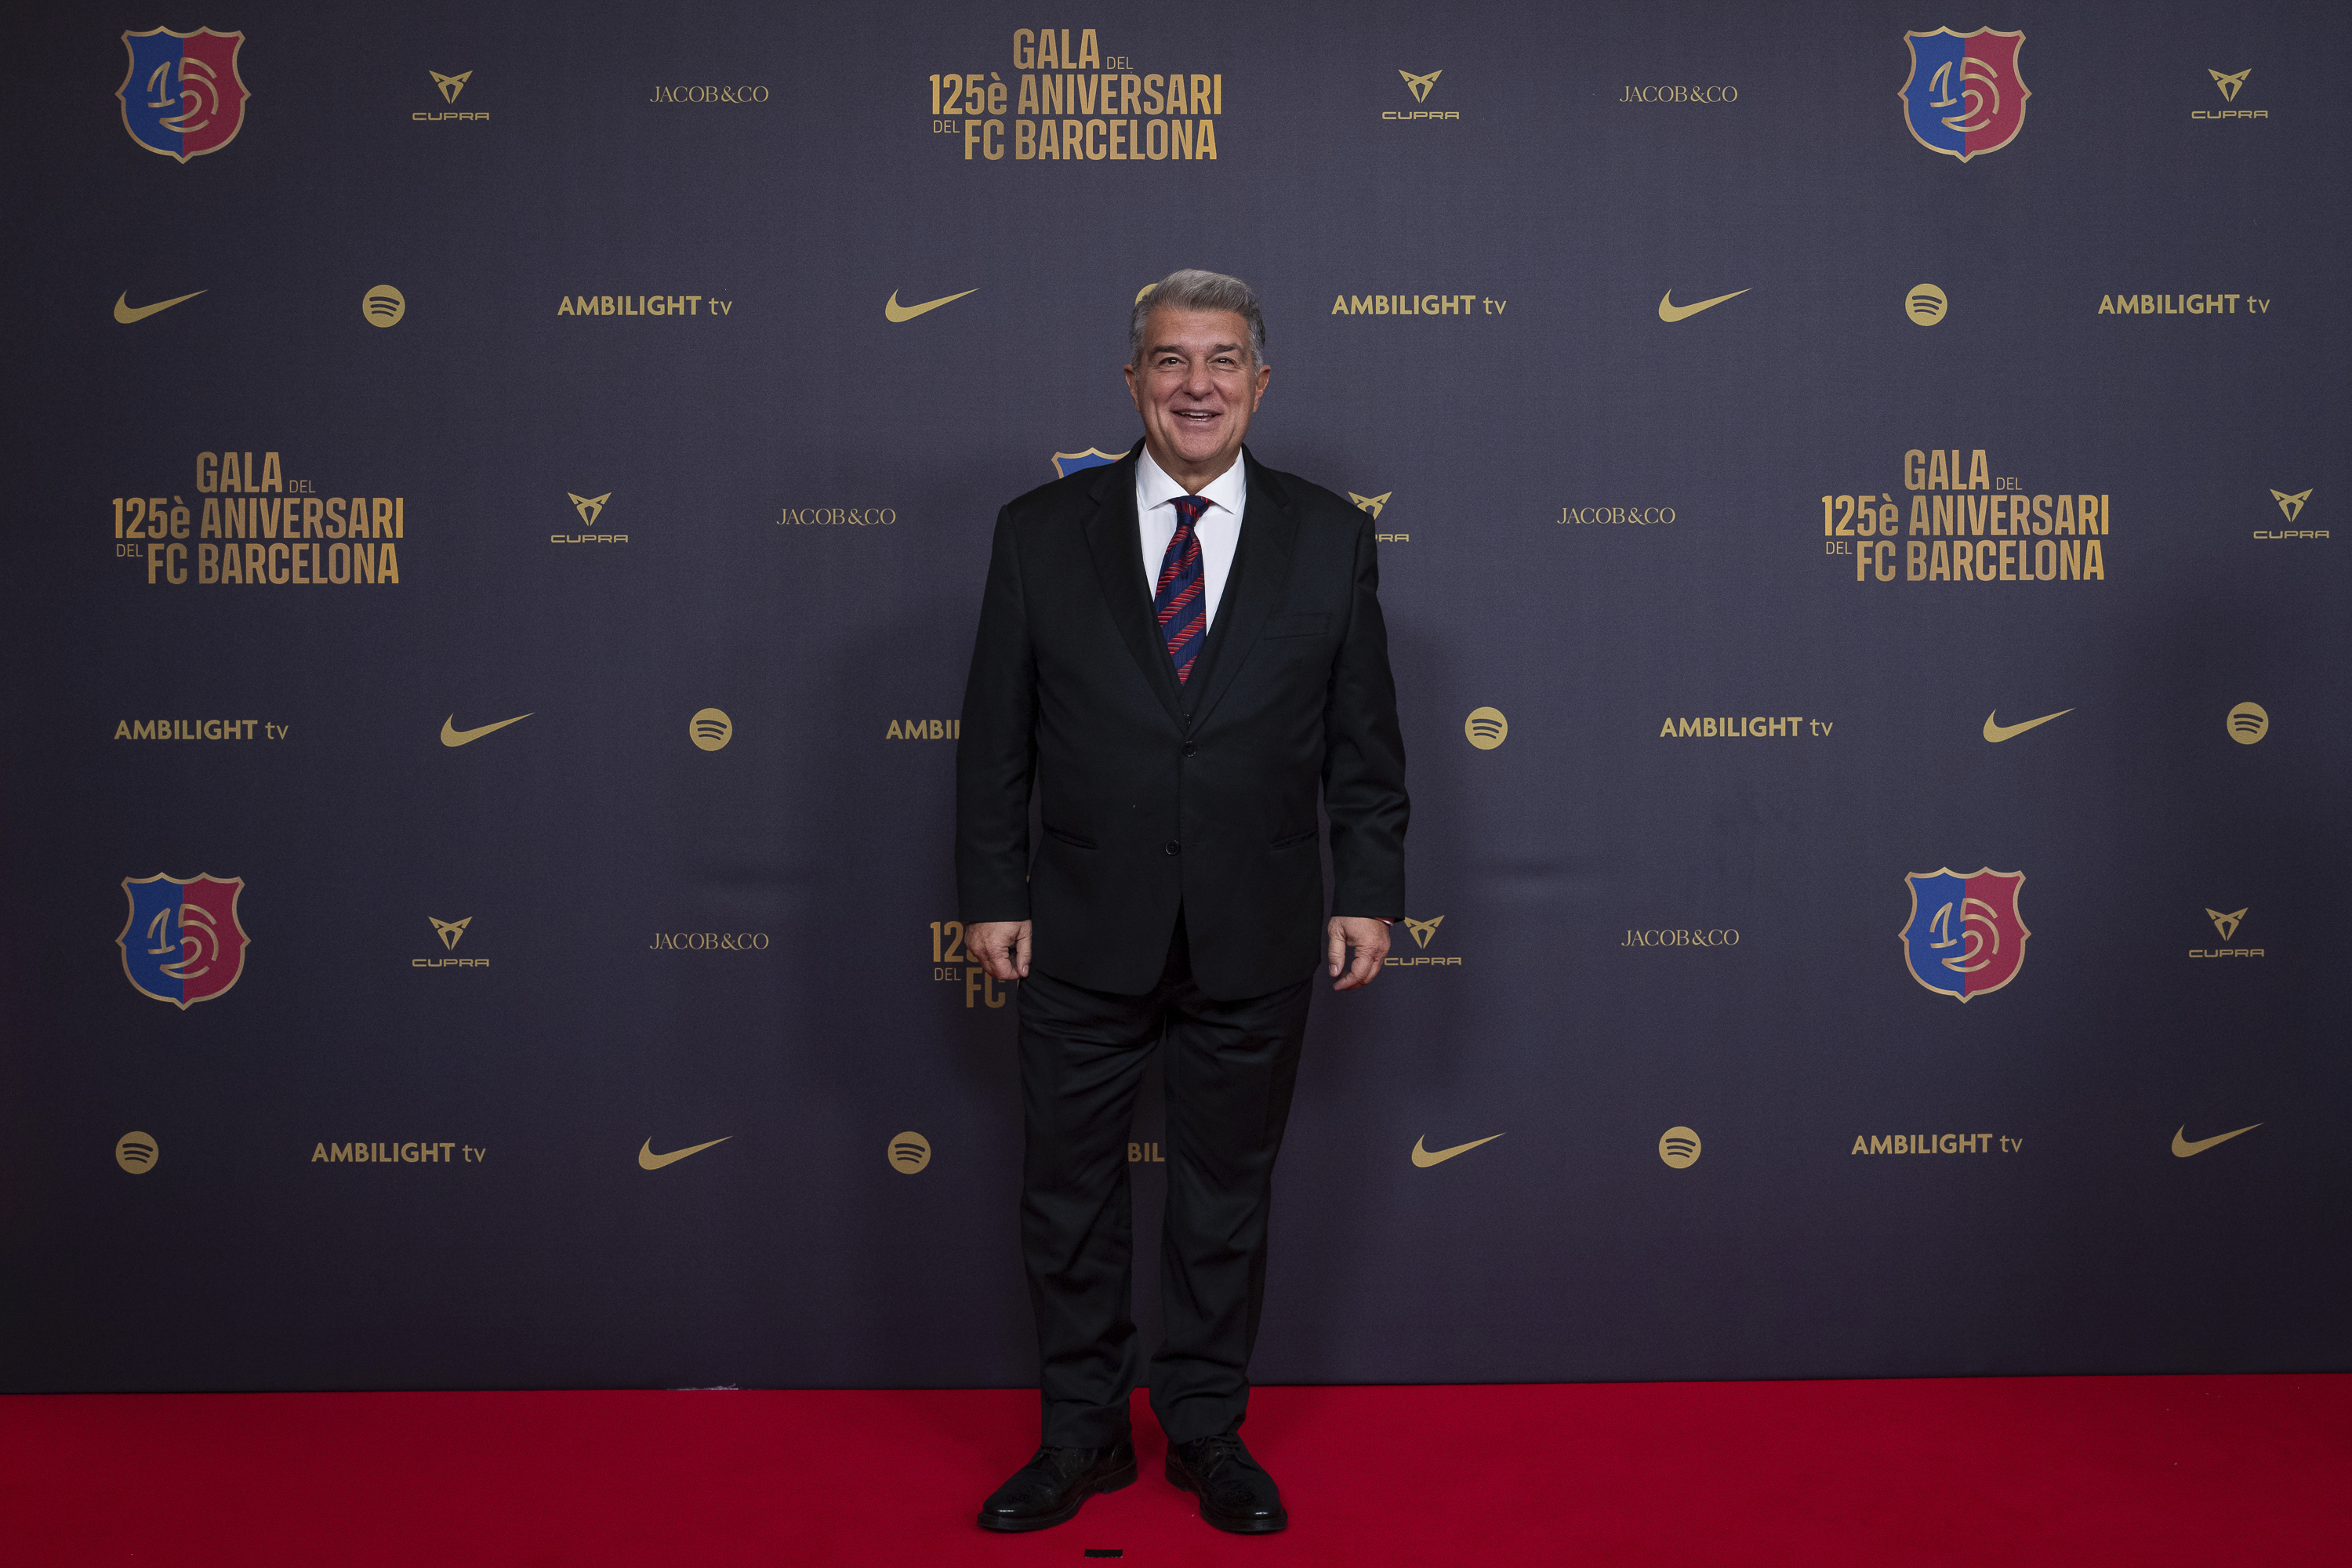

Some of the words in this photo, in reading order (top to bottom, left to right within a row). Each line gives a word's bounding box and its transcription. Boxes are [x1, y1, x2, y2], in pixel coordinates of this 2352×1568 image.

[1014, 29, 1099, 69] GALA
[1107, 56, 1133, 69] DEL
[650, 86, 768, 103] JACOB&CO
[930, 72, 1007, 114] 125è
[1018, 74, 1221, 114] ANIVERSARI
[1620, 86, 1737, 103] JACOB&CO
[934, 120, 960, 132] DEL
[965, 119, 1004, 160] FC
[1016, 119, 1217, 160] BARCELONA
[557, 296, 701, 315] AMBILIGHT
[709, 298, 731, 315] tv
[1332, 295, 1475, 314] AMBILIGHT
[1483, 297, 1506, 314] tv
[2098, 294, 2240, 314] AMBILIGHT
[2247, 296, 2270, 313] tv
[197, 452, 282, 492] GALA
[289, 480, 315, 493] DEL
[1905, 449, 1989, 490] GALA
[1996, 477, 2022, 490] DEL
[113, 496, 189, 539] 125è
[201, 498, 403, 538] ANIVERSARI
[777, 509, 895, 525] JACOB&CO
[1557, 508, 1675, 524] JACOB&CO
[1822, 494, 1898, 535] 125è
[1910, 495, 2108, 535] ANIVERSARI
[117, 544, 142, 557] DEL
[148, 543, 187, 584] FC
[199, 543, 399, 584] BARCELONA
[1826, 541, 1852, 554] DEL
[1857, 541, 1895, 581] FC
[1907, 540, 2104, 581] BARCELONA
[114, 720, 257, 739] AMBILIGHT
[265, 722, 288, 739] tv
[1661, 717, 1802, 737] AMBILIGHT
[1810, 719, 1832, 736] tv
[650, 933, 768, 950] JACOB&CO
[930, 921, 978, 963] 12
[1621, 930, 1739, 946] JACOB&CO
[1384, 957, 1461, 966] CUPRA
[2189, 949, 2264, 957] CUPRA
[935, 967, 961, 981] DEL
[966, 967, 1006, 1008] FC
[312, 1142, 455, 1162] AMBILIGHT
[463, 1145, 485, 1162] tv
[1852, 1134, 1992, 1154] AMBILIGHT
[2000, 1136, 2022, 1152] tv
